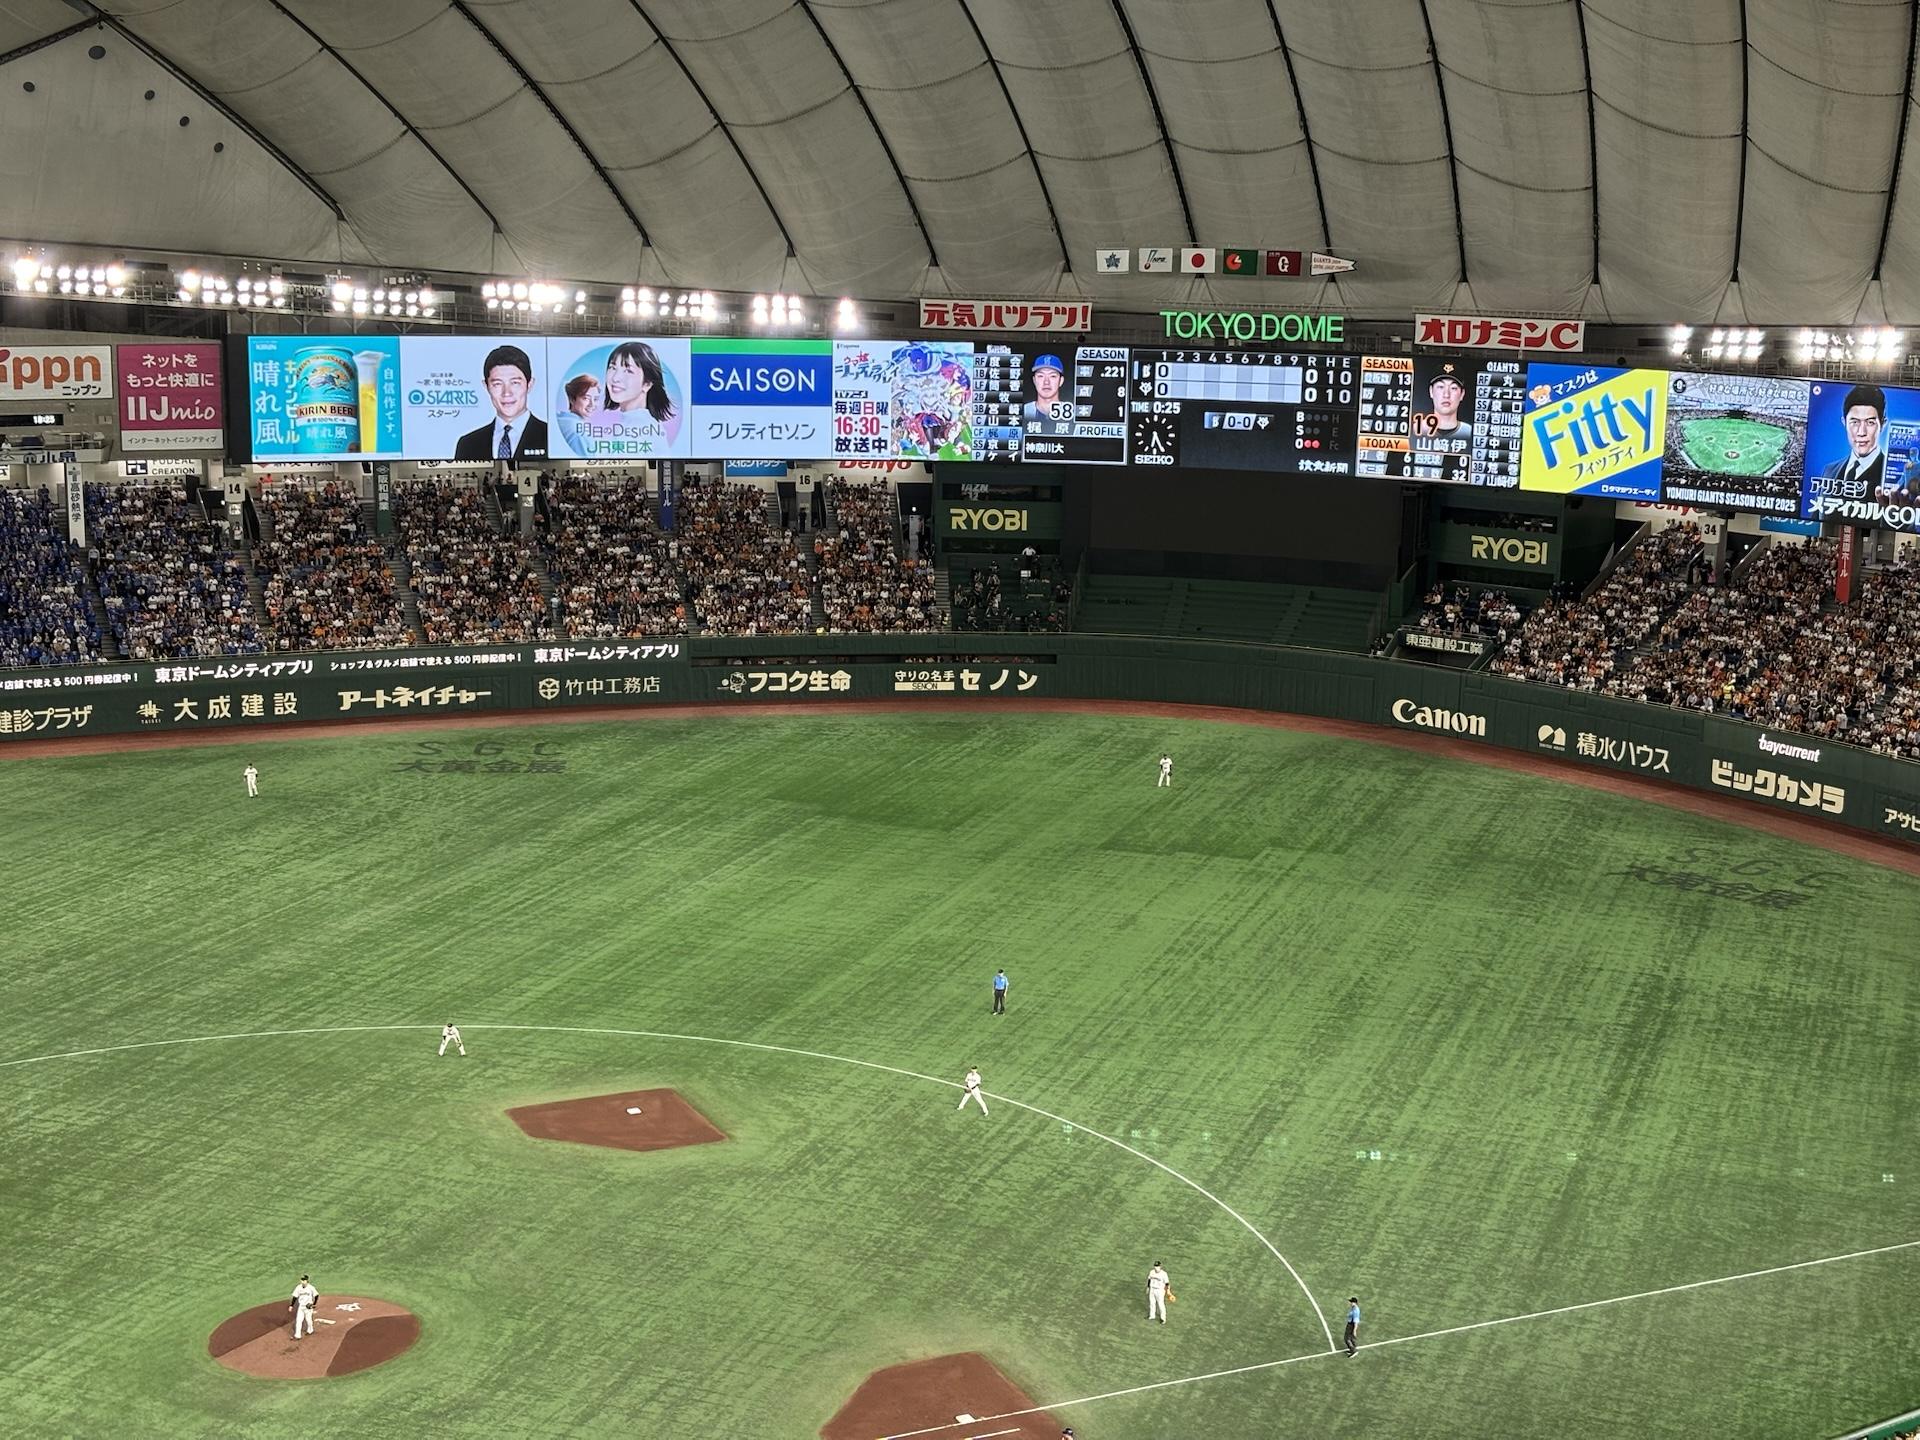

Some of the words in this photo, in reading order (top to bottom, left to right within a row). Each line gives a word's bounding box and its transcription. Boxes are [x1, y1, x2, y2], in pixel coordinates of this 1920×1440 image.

[923, 303, 1089, 329] 元気ハツラツ!
[1159, 311, 1256, 340] TOKYO
[1262, 314, 1344, 342] DOME
[1419, 318, 1579, 350] オロナミンC
[1082, 350, 1124, 359] SEASON
[1162, 351, 1166, 361] 1
[1176, 352, 1184, 362] 2
[1193, 353, 1200, 362] 3
[1209, 353, 1217, 362] 4
[1225, 354, 1233, 363] 5
[1242, 354, 1249, 364] 6
[1258, 355, 1265, 365] 7
[1274, 355, 1282, 365] 8
[1290, 356, 1298, 365] 9
[1308, 357, 1316, 366] R
[1326, 357, 1335, 367] H
[1343, 358, 1350, 368] E
[142, 354, 198, 368] ネットを
[1365, 359, 1408, 370] SEASON
[1487, 362, 1519, 372] GIANTS
[1101, 366, 1125, 377] .221
[1159, 364, 1168, 378] 0
[1305, 369, 1318, 384] 0
[1327, 371, 1334, 384] 1
[1340, 371, 1352, 385] 0
[127, 373, 214, 387] もっと快適に
[709, 368, 815, 392] SAISON
[1398, 375, 1411, 385] 13
[1479, 376, 1488, 384] RF
[1503, 376, 1514, 387] 丸
[1553, 369, 1599, 396] マスクは
[62, 384, 101, 396] ニップン
[1079, 386, 1089, 396] 点
[1117, 387, 1125, 397] 8
[1158, 383, 1168, 395] 0
[1305, 387, 1317, 402] 0
[1326, 389, 1332, 403] 1
[1339, 390, 1351, 404] 0
[1387, 389, 1410, 400] 1.32
[1478, 389, 1487, 397] CF
[1493, 389, 1523, 399] オコエ
[253, 360, 283, 444] 晴れ風
[427, 390, 478, 405] STARTS
[999, 392, 1010, 403] 牧
[299, 405, 327, 416] KIRIN
[330, 405, 353, 415] BEER
[835, 401, 889, 415] 毎週日曜
[1050, 402, 1073, 420] 58
[1079, 406, 1089, 416] 本
[1118, 407, 1123, 417] 1
[1131, 402, 1149, 412] TIME
[1153, 402, 1181, 414] 0:25
[1376, 405, 1382, 415] 6
[1401, 406, 1408, 416] 2
[1477, 401, 1487, 410] SS
[428, 410, 460, 418] スターツ
[1296, 412, 1304, 422] B
[1476, 414, 1486, 422] 2B
[988, 416, 1019, 426] 山本
[1228, 416, 1250, 428] 0-0
[1362, 421, 1369, 431] S
[1375, 421, 1382, 432] 0
[1386, 422, 1394, 432] H
[1400, 422, 1408, 432] 0
[1414, 414, 1439, 436] 19
[708, 423, 815, 440] クレディセゾン
[1080, 427, 1123, 436] PROFILE
[1296, 425, 1304, 435] S
[1476, 426, 1485, 434] 1B
[1532, 388, 1653, 470] Fitty
[587, 441, 653, 453] JR東日本
[835, 437, 888, 453] 放送中
[988, 440, 1018, 449] 京田
[1026, 443, 1064, 454] 神奈川大
[1365, 439, 1400, 448] TODAY
[1475, 438, 1484, 447] LF
[1489, 439, 1520, 451] 中山
[1135, 454, 1174, 465] SEIKO
[1404, 452, 1411, 462] 6
[1459, 457, 1467, 467] 0
[1476, 451, 1482, 459] C
[1473, 463, 1483, 471] 3B
[1569, 446, 1634, 481] フィッティ
[800, 475, 810, 484] 16
[1403, 467, 1410, 477] 0
[1452, 470, 1466, 480] 32
[524, 476, 531, 487] 4
[229, 484, 241, 493] 14
[1810, 477, 1868, 499] アリナミン
[1666, 486, 1696, 499] YOMIURI
[1697, 490, 1725, 503] GIANTS
[1726, 493, 1756, 508] SEASON
[1757, 496, 1774, 510] SEAT
[1775, 498, 1796, 512] 2025
[950, 508, 1028, 531] RYOBI
[1704, 524, 1716, 535] 34
[1471, 534, 1548, 565] RYOBI
[1406, 633, 1483, 655] 東亜建設工業
[454, 655, 470, 664] 500
[534, 644, 679, 663] 東京ドームシティアプリ
[155, 660, 314, 683] 東京ドームシティアプリ
[894, 670, 955, 682] 守りの名手
[64, 677, 82, 686] 500
[566, 676, 661, 696] 竹中工務店
[748, 670, 852, 693] フコク生命
[960, 669, 1038, 691] セノン
[338, 685, 492, 711] アートネイチャー
[174, 692, 298, 722] 大成建設
[1391, 698, 1486, 736] Canon
[1576, 732, 1670, 774] 積水ハウス
[1758, 733, 1821, 762] baycurrent
[1711, 758, 1845, 814] ビックカメラ
